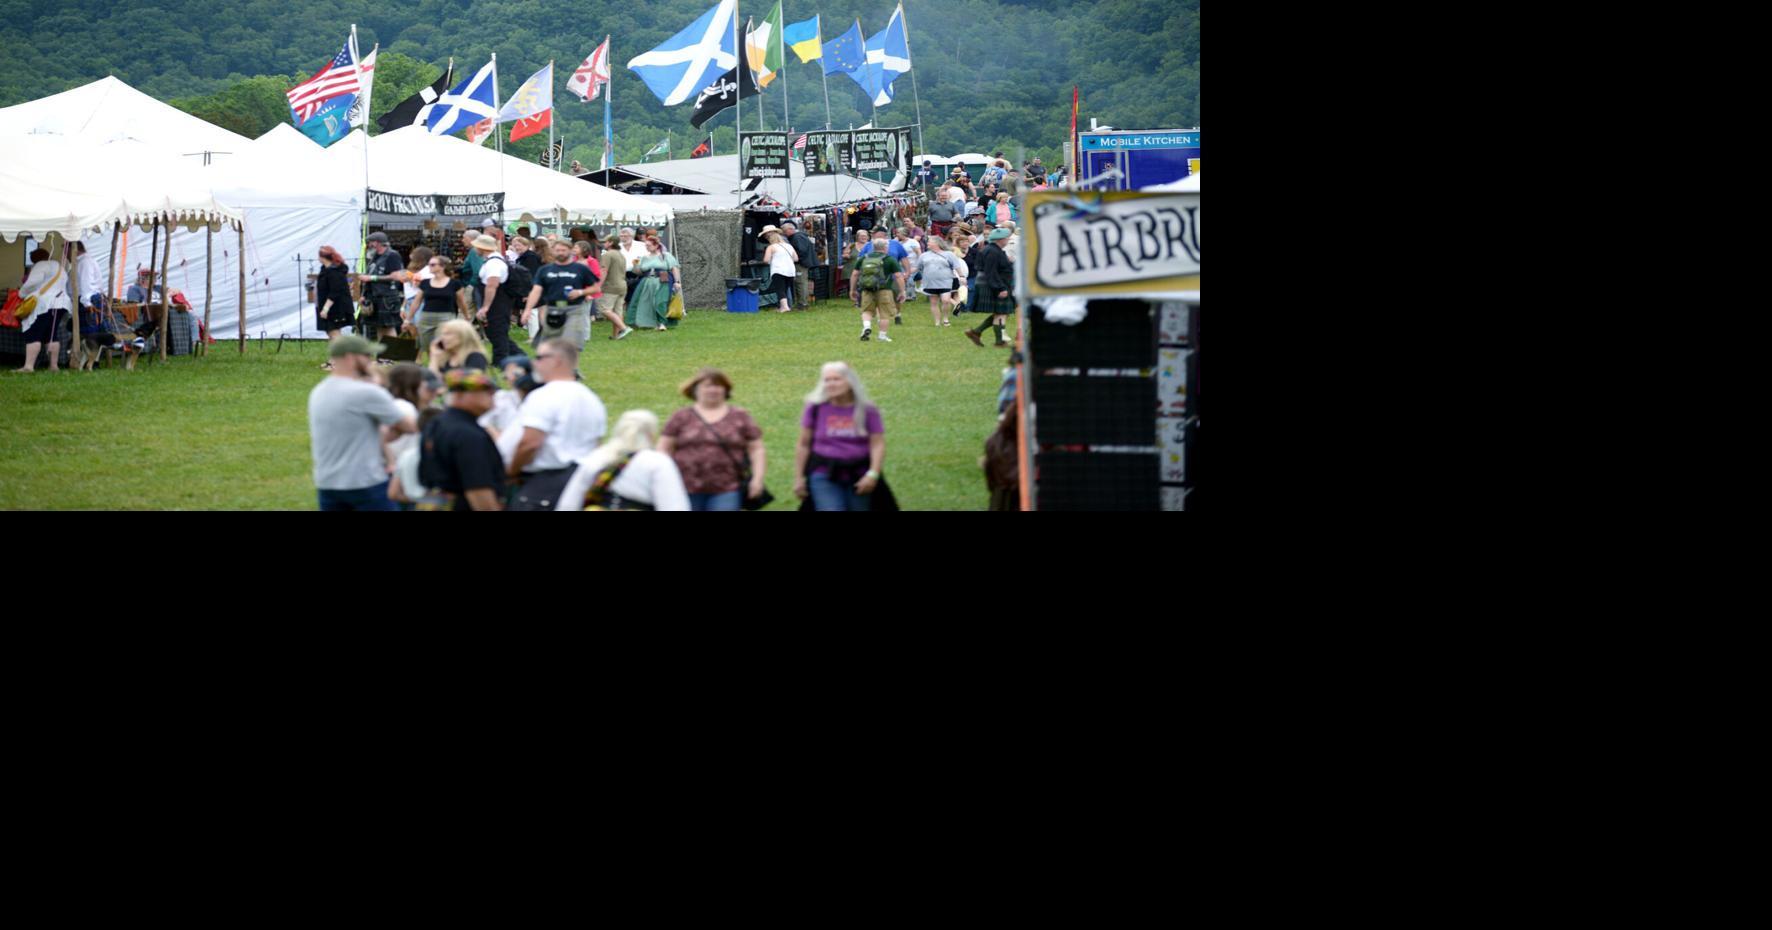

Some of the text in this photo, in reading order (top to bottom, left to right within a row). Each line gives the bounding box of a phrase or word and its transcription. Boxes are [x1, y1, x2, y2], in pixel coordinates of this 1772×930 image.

[752, 135, 786, 146] CELTIC JACKALOPE
[808, 134, 824, 146] CELTIC
[855, 132, 888, 143] CELTIC JACKALOPE
[1100, 136, 1191, 147] MOBILE KITCHEN
[368, 191, 391, 212] HOLY
[446, 194, 495, 205] AMERICAN MADE
[467, 203, 498, 215] PRODUCTS
